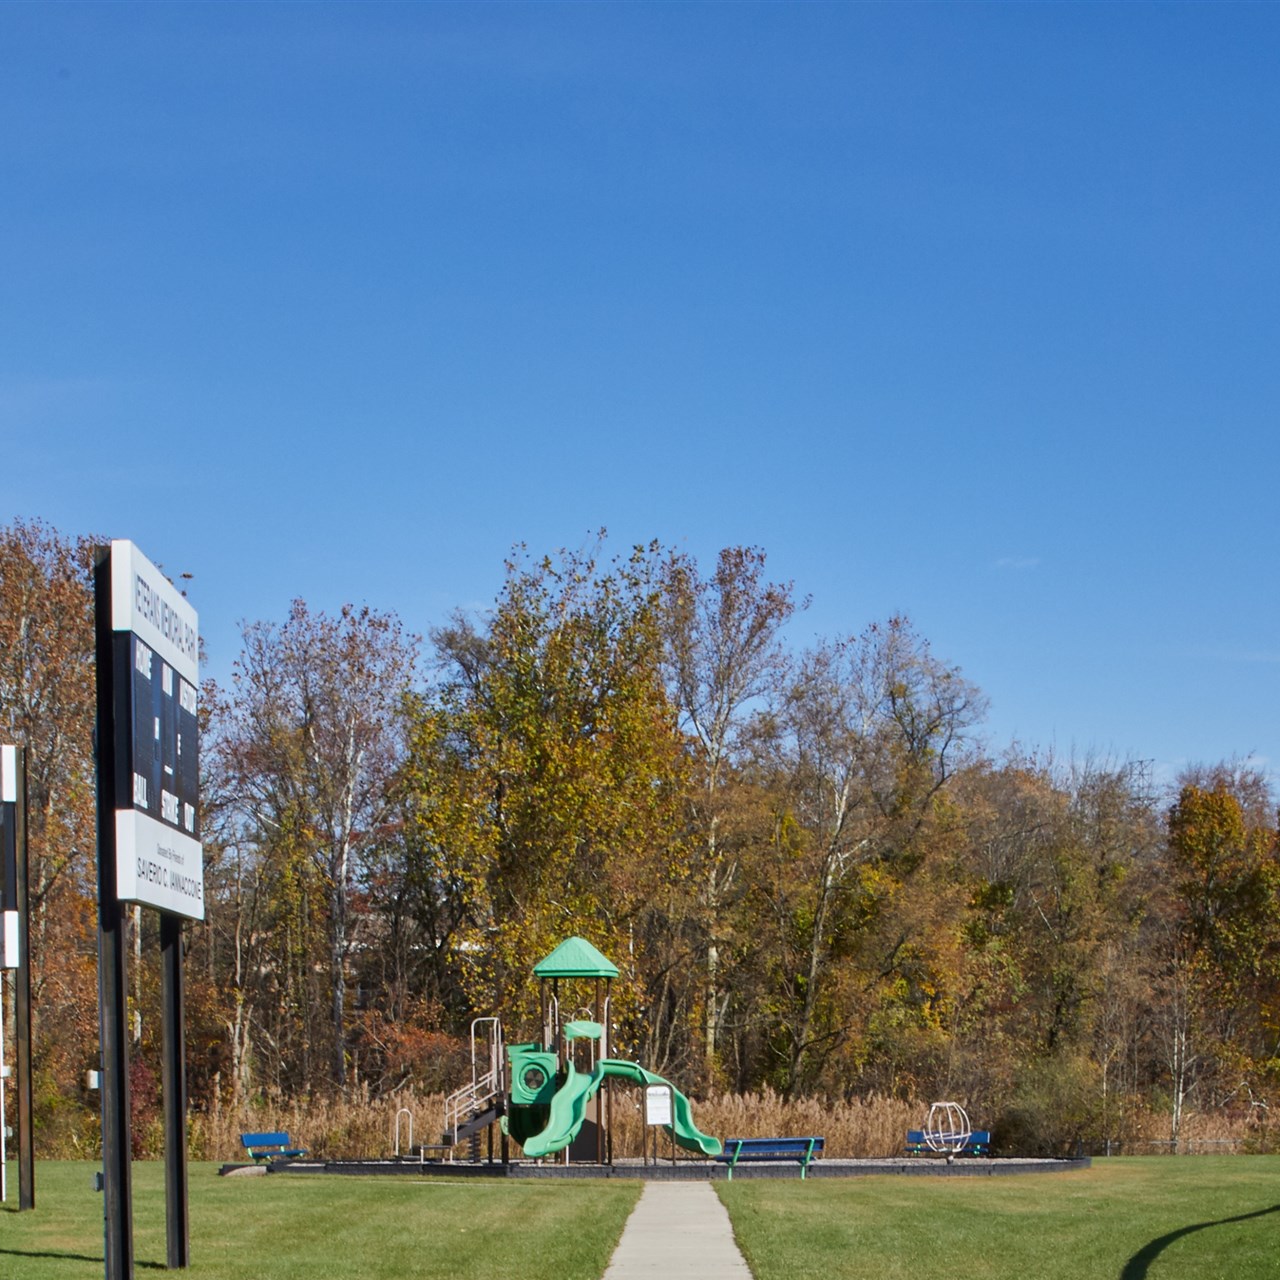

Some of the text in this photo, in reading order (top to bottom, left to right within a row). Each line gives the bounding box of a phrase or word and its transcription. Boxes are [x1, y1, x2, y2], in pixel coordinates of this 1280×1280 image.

[133, 772, 148, 809] BALL
[184, 802, 195, 833] OUT
[137, 857, 202, 900] SAVERIO C. IANNACCONE
